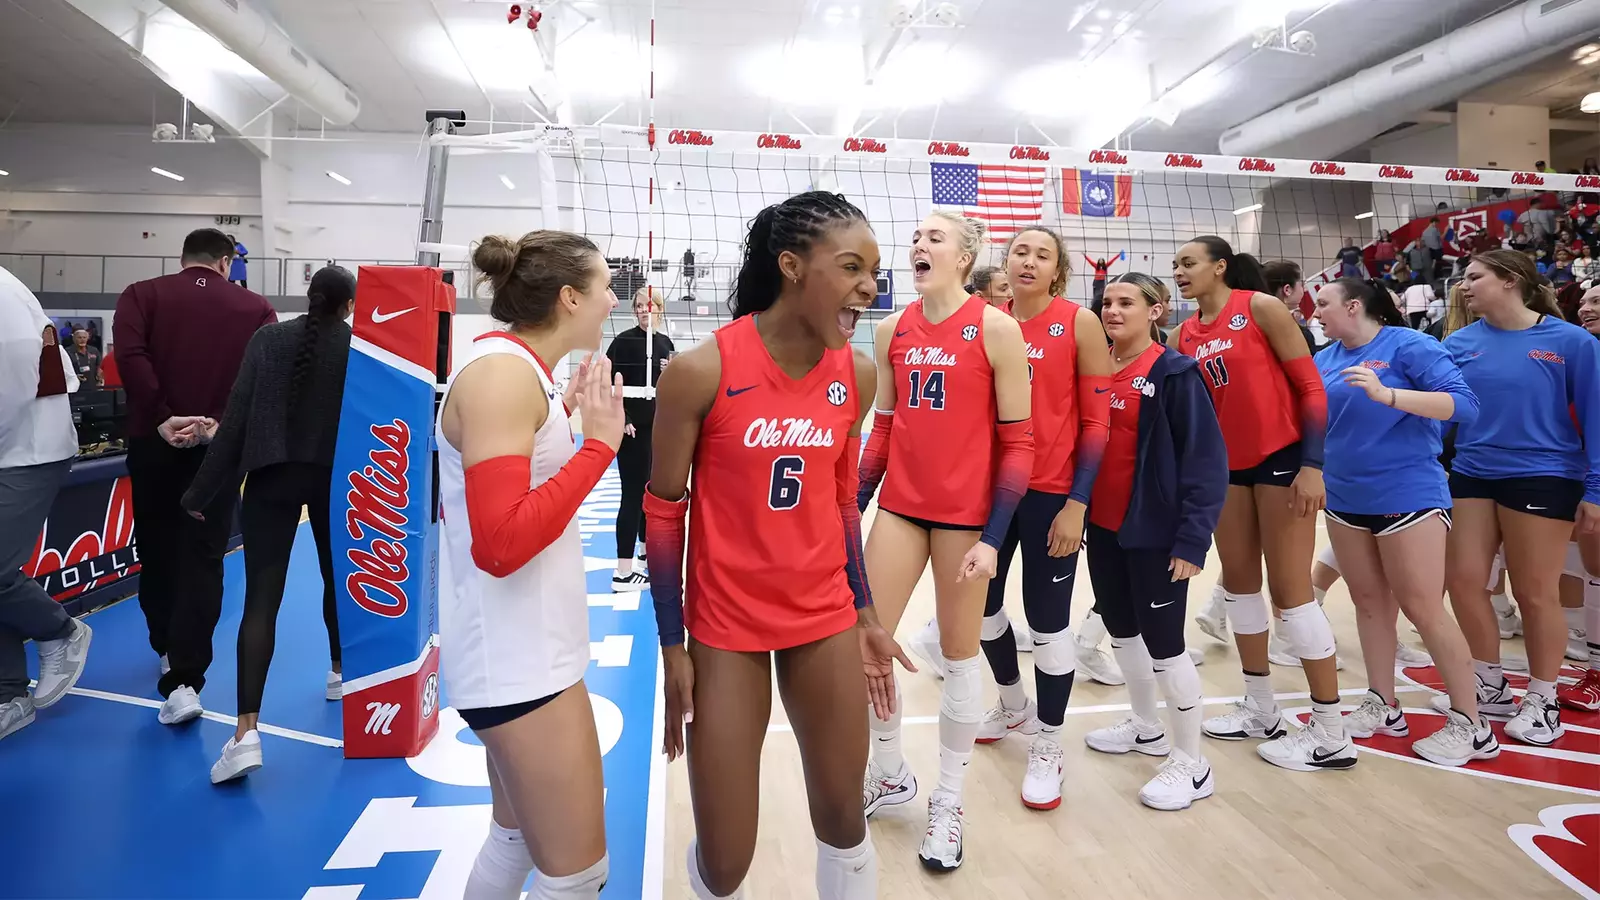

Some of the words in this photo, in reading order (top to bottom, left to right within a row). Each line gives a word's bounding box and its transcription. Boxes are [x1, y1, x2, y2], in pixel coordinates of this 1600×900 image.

[962, 324, 978, 341] SEC
[1049, 323, 1064, 337] SEC
[904, 347, 924, 366] Ole
[923, 346, 957, 366] Miss
[1208, 338, 1233, 356] Miss
[1205, 355, 1229, 388] 11
[827, 381, 847, 406] SEC
[908, 370, 946, 410] 14
[743, 417, 783, 449] Ole
[782, 417, 834, 448] Miss
[346, 417, 411, 541] Miss
[768, 455, 805, 511] 6
[346, 537, 409, 619] Ole
